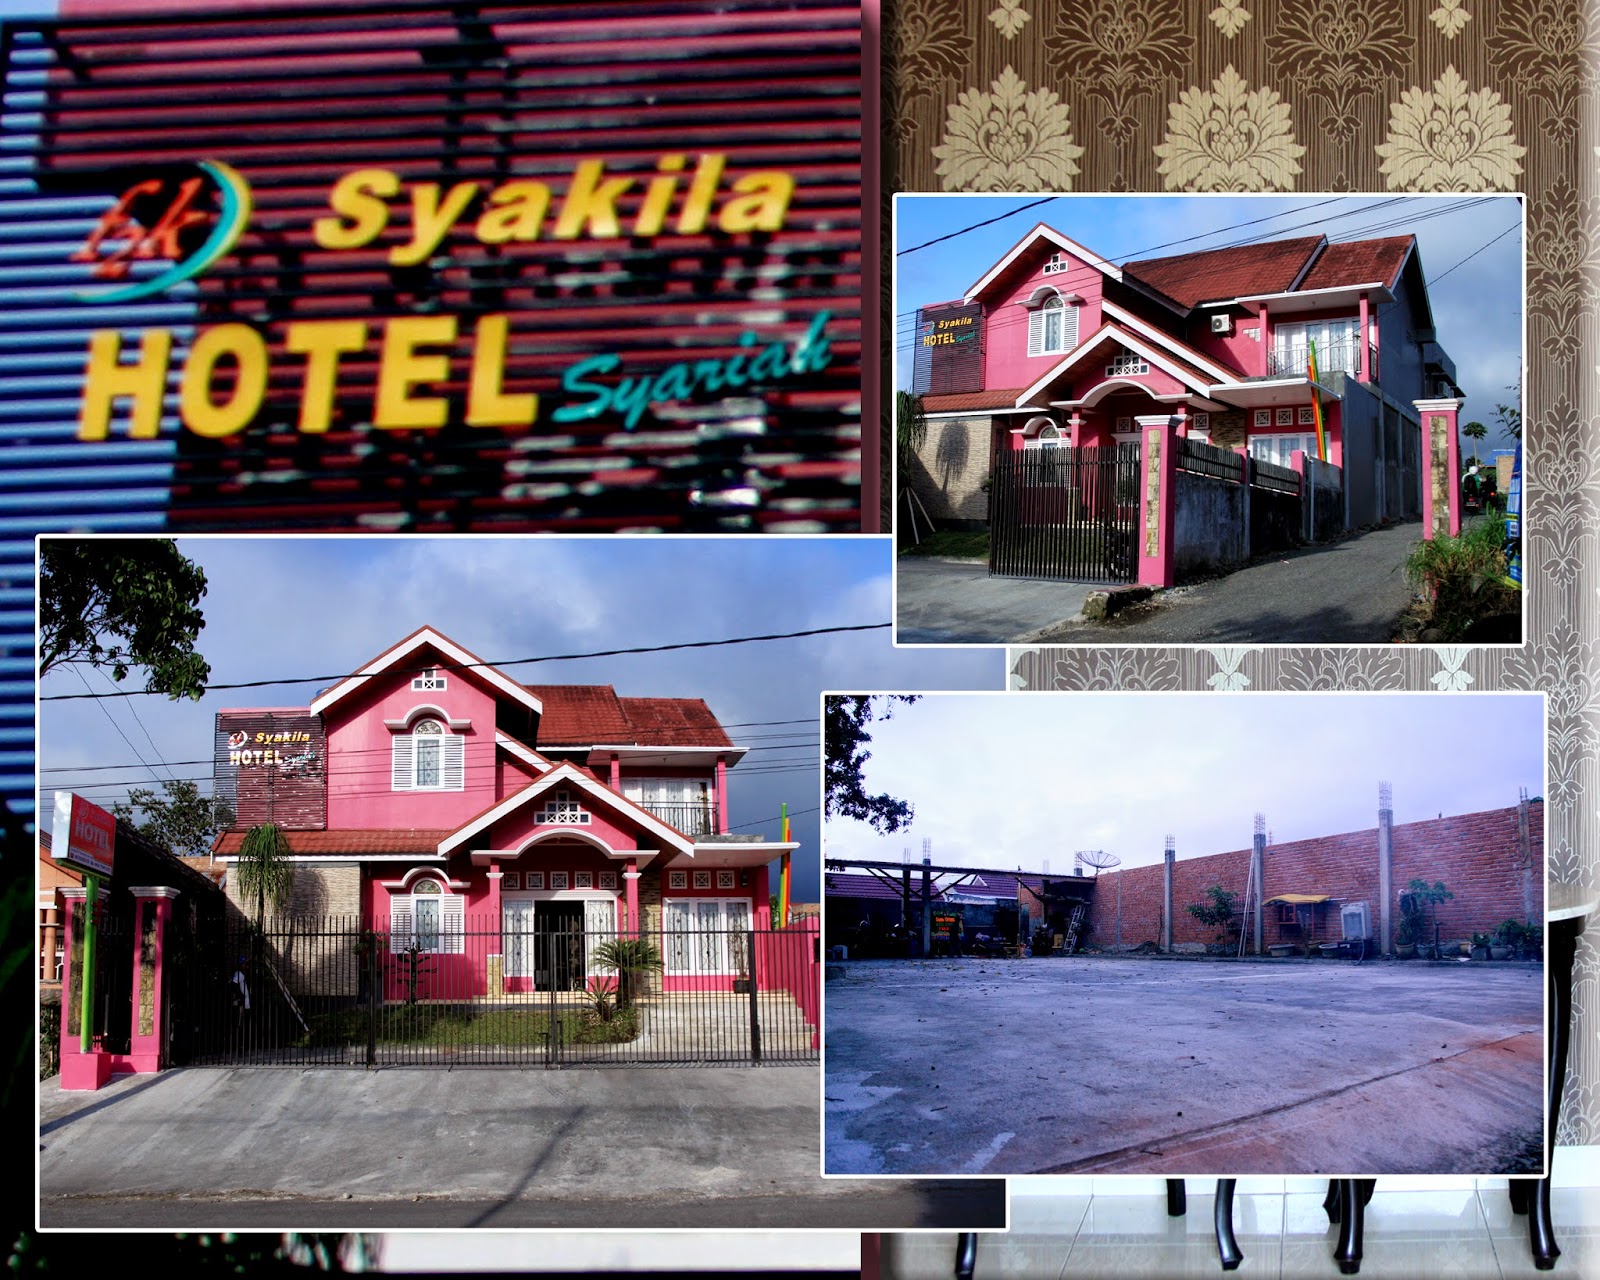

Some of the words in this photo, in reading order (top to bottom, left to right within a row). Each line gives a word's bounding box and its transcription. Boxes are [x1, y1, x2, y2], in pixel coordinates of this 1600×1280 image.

[313, 154, 795, 265] Syakila
[939, 317, 972, 329] Syakila
[924, 333, 955, 346] HOTEL
[77, 315, 539, 441] HOTEL
[552, 309, 832, 429] Syariah
[255, 731, 310, 745] Syakila
[229, 749, 283, 766] HOTEL
[75, 819, 110, 851] HOTEL
